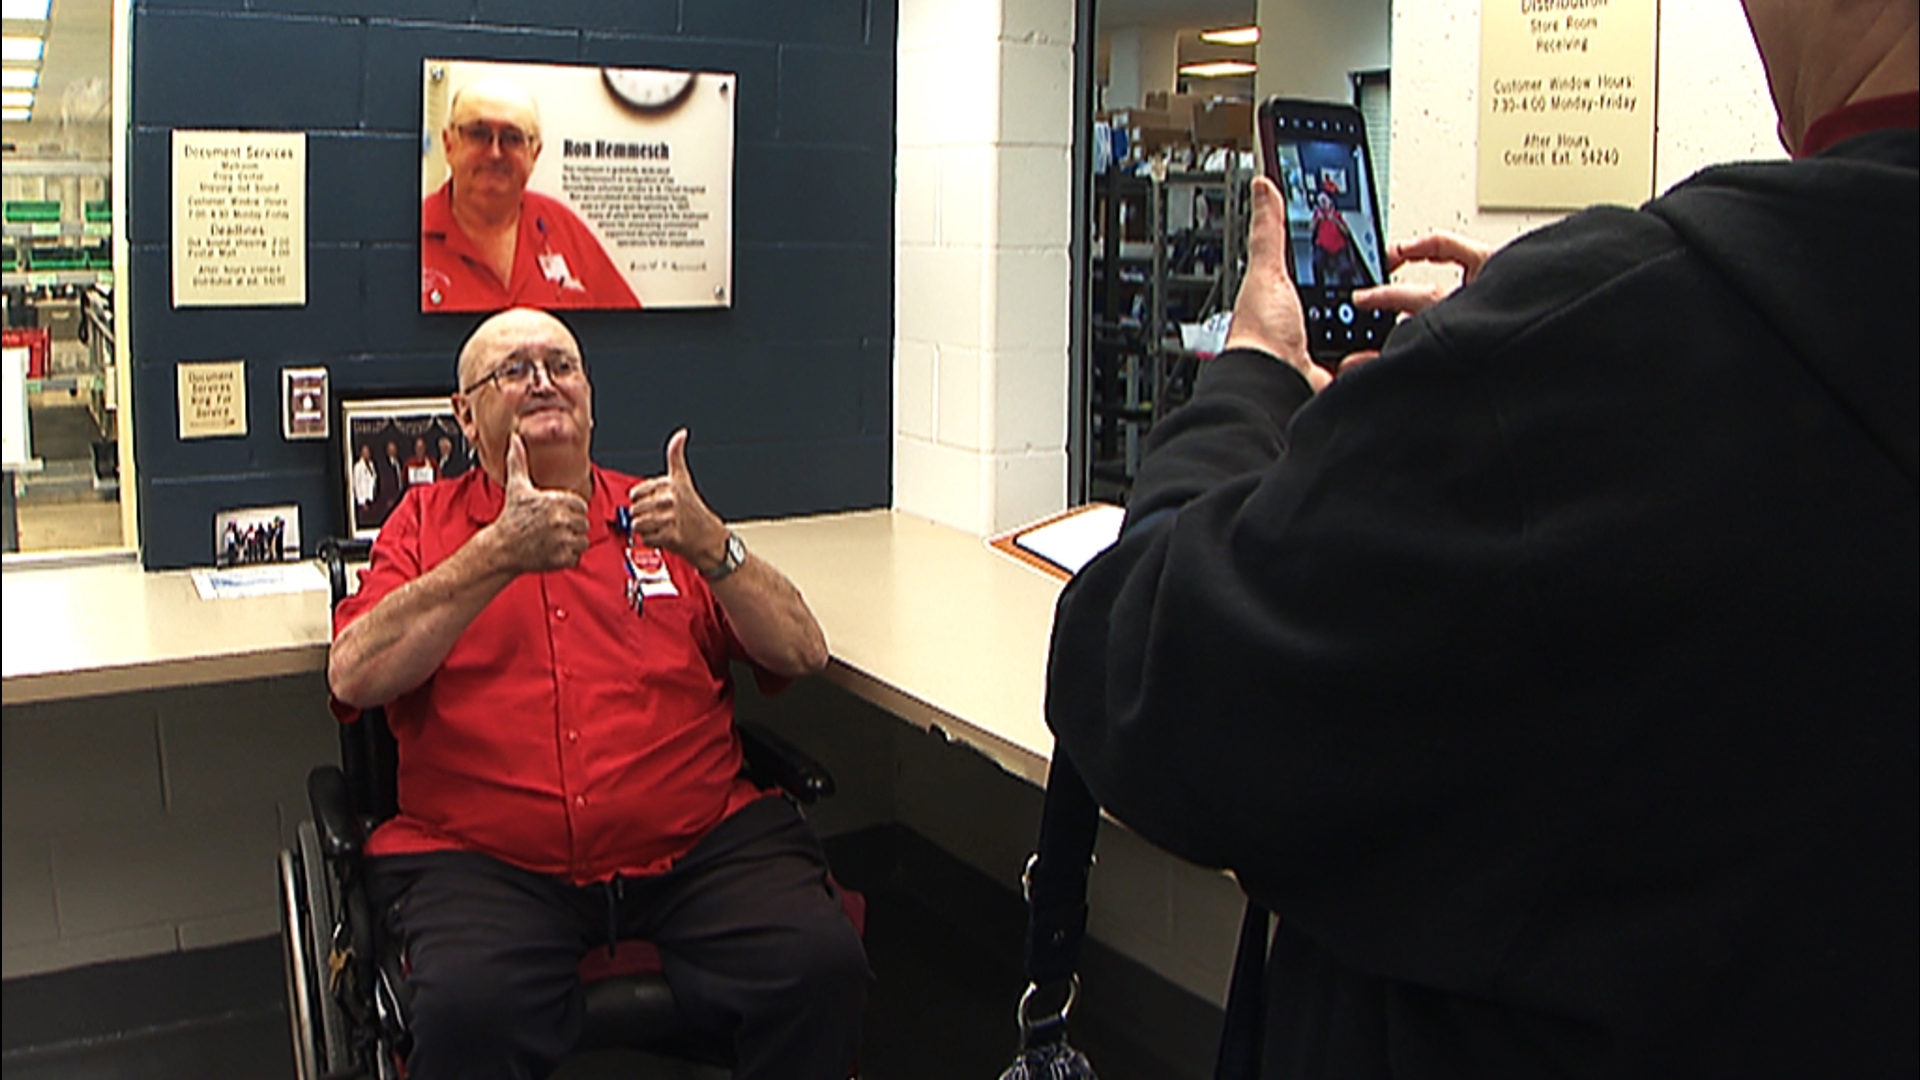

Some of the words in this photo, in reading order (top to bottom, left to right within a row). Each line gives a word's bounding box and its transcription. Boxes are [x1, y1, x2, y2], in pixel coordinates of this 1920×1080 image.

[1522, 0, 1608, 14] Distribution
[1531, 18, 1558, 33] Store
[1566, 15, 1598, 30] Room
[1537, 37, 1588, 52] Receiving
[1494, 79, 1542, 95] Customer
[1550, 76, 1591, 91] Window
[1524, 133, 1550, 148] After
[1557, 133, 1590, 148] Hours
[184, 144, 241, 159] Document
[246, 145, 293, 160] Services
[563, 139, 592, 158] Ron
[595, 140, 669, 160] Hemmesch
[1504, 150, 1545, 166] Contact
[1581, 148, 1619, 166] 54240
[210, 223, 265, 237] Deadlines
